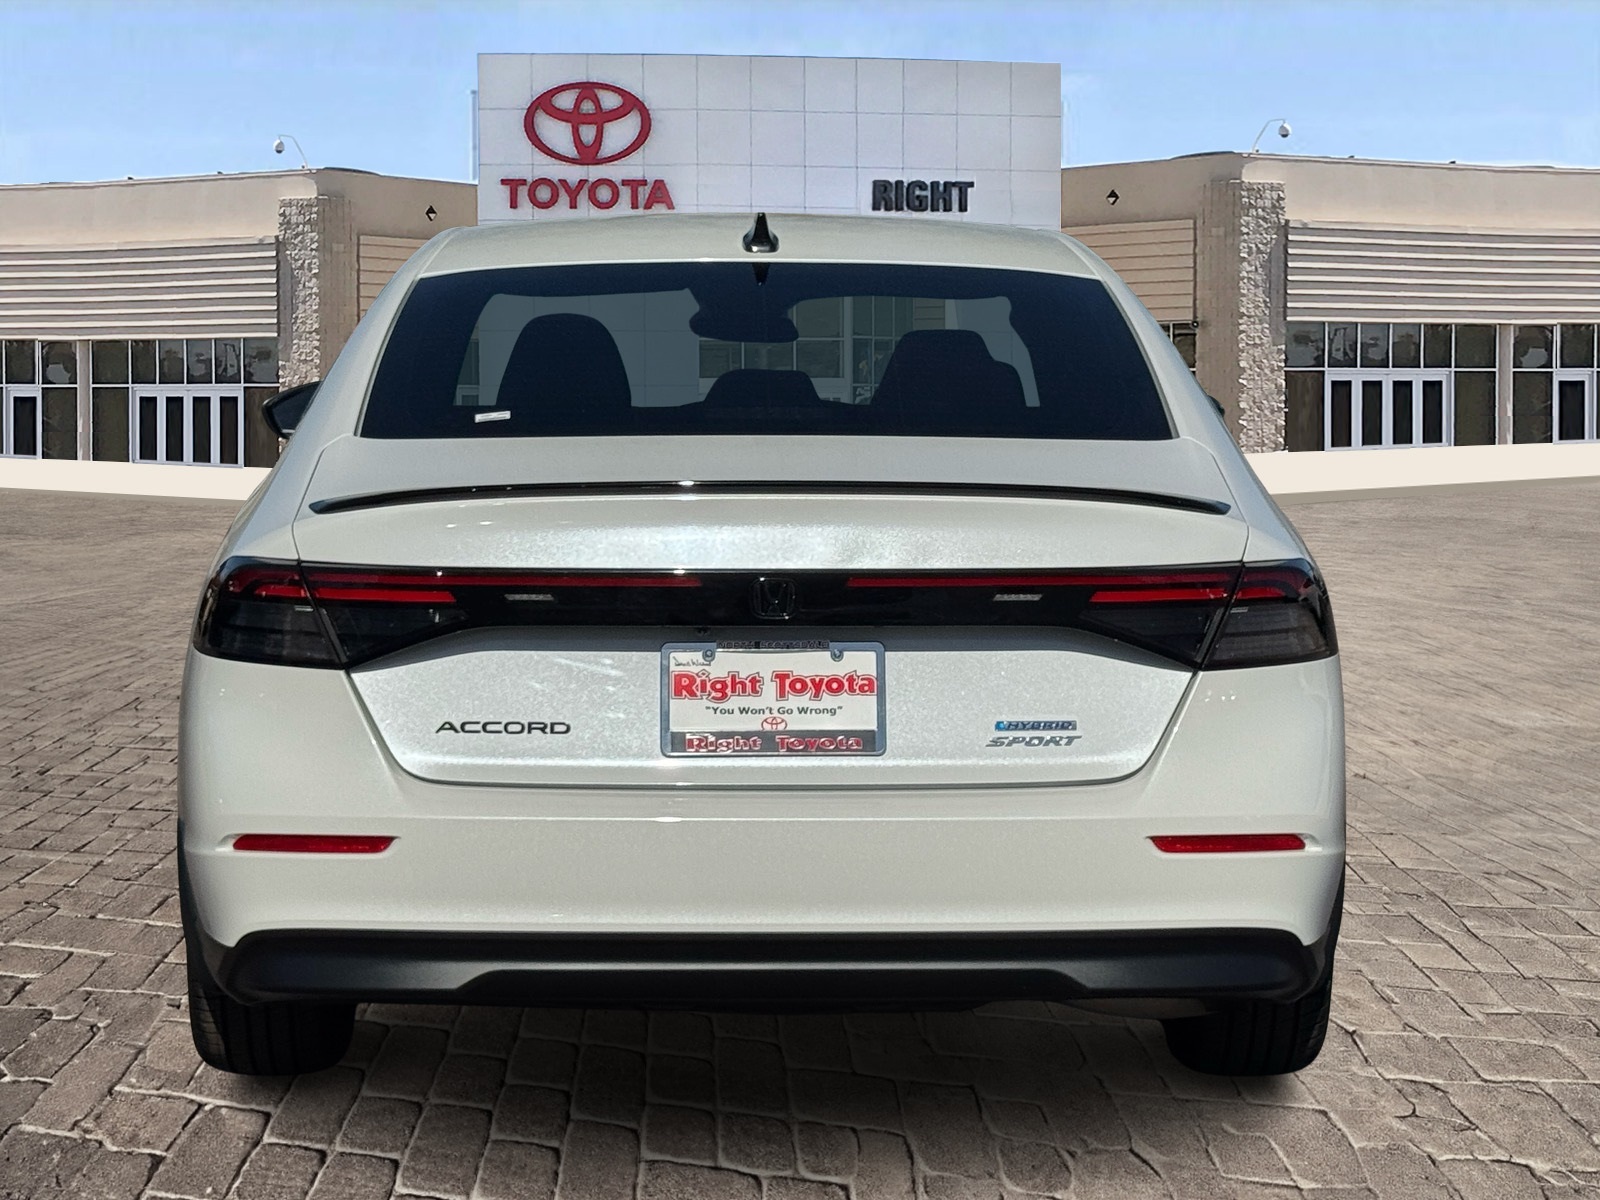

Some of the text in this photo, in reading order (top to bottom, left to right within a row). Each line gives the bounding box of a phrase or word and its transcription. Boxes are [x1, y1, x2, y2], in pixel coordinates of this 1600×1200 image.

[501, 177, 675, 209] TOYOTA
[872, 179, 974, 212] RIGHT
[671, 669, 877, 703] Right Toyota
[738, 705, 774, 715] Won't
[777, 706, 793, 715] Go
[435, 721, 571, 734] ACCORD
[1006, 720, 1074, 731] HYBRID
[685, 733, 863, 753] Right Toyota
[985, 735, 1082, 747] SPORT
